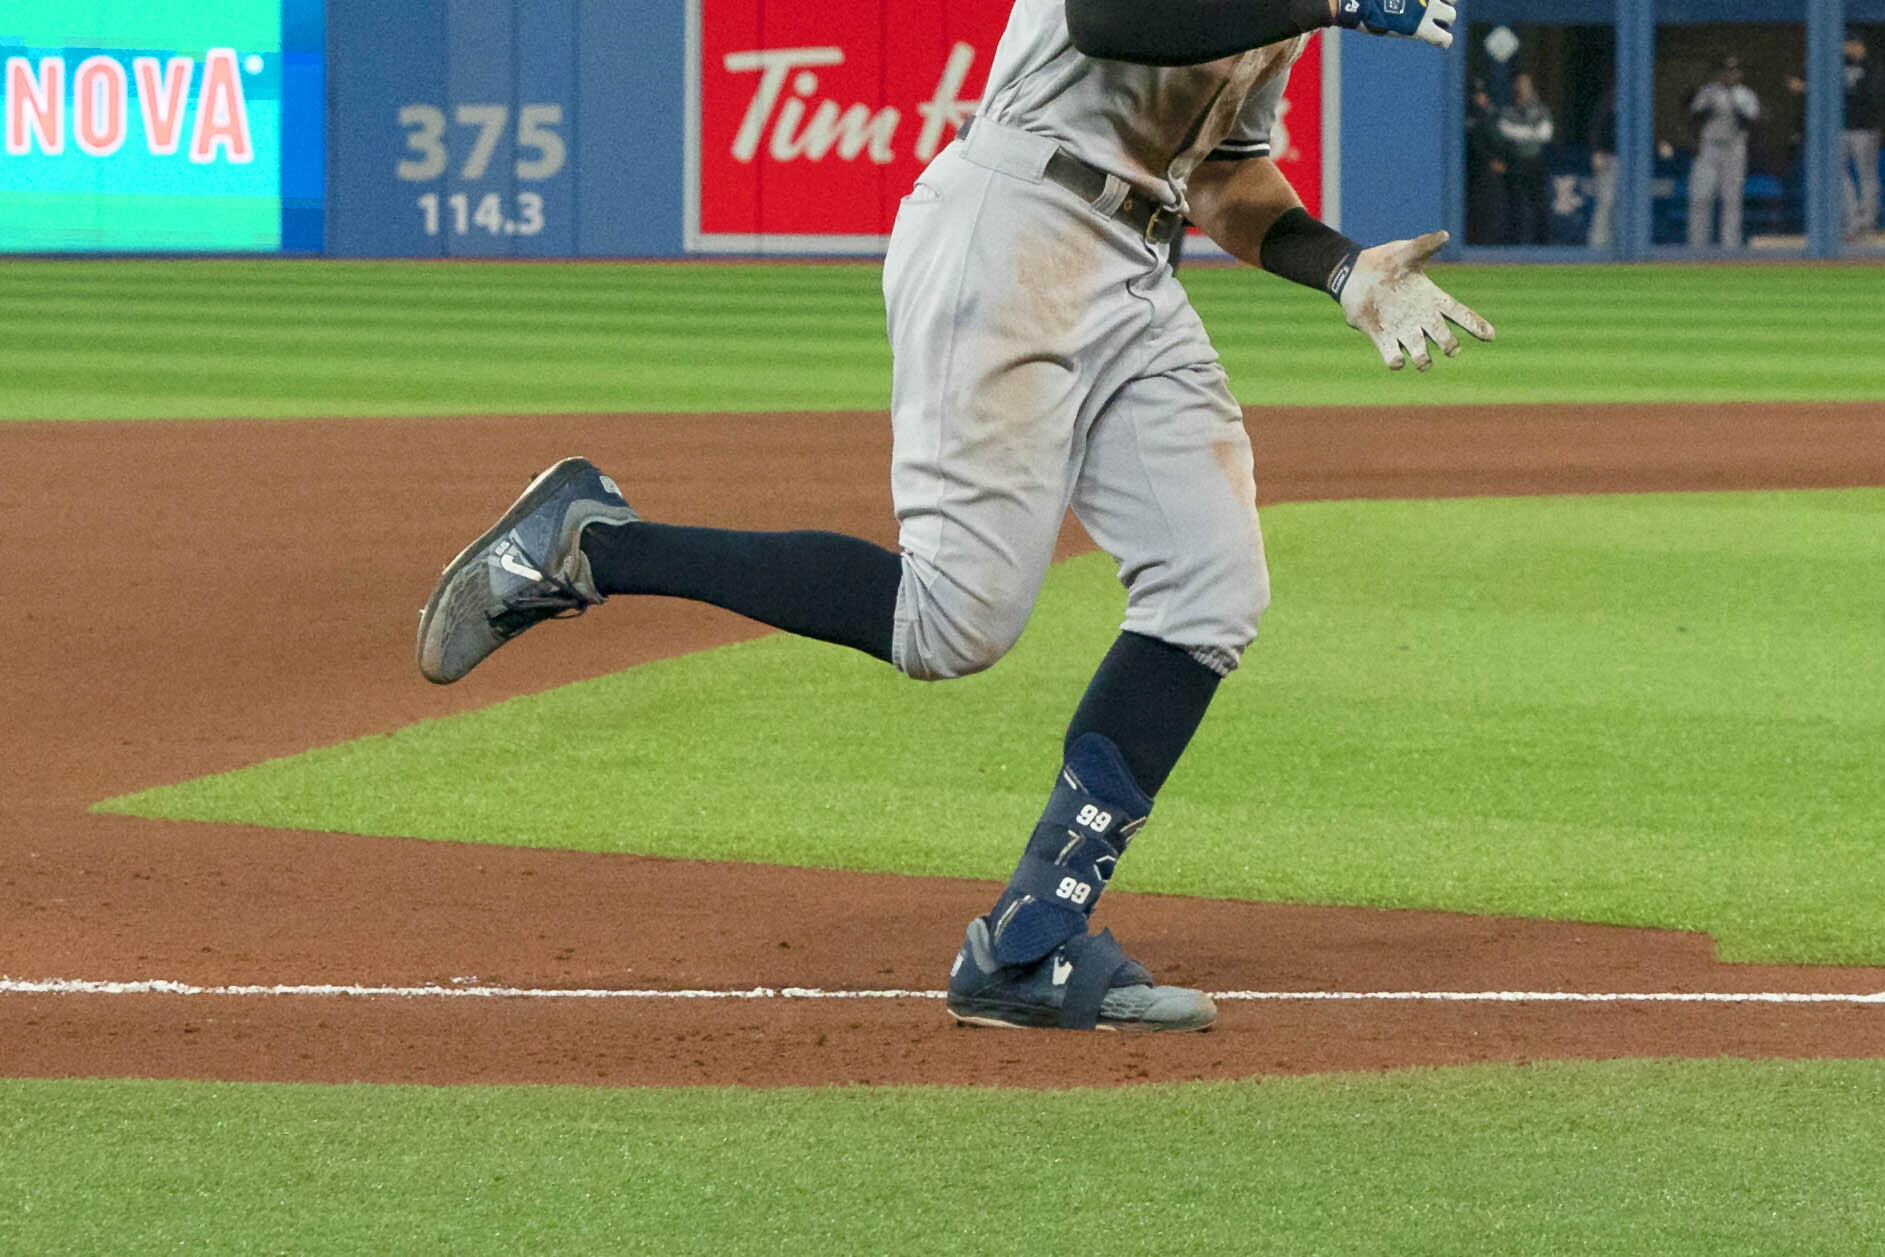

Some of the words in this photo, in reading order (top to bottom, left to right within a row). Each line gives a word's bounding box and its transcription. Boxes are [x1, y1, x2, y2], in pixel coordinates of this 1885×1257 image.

[6, 47, 254, 164] NOVA
[724, 46, 900, 164] Tim
[397, 103, 567, 181] 375
[418, 192, 546, 235] 114.3
[1075, 804, 1112, 832] 99
[1055, 876, 1092, 904] 99
